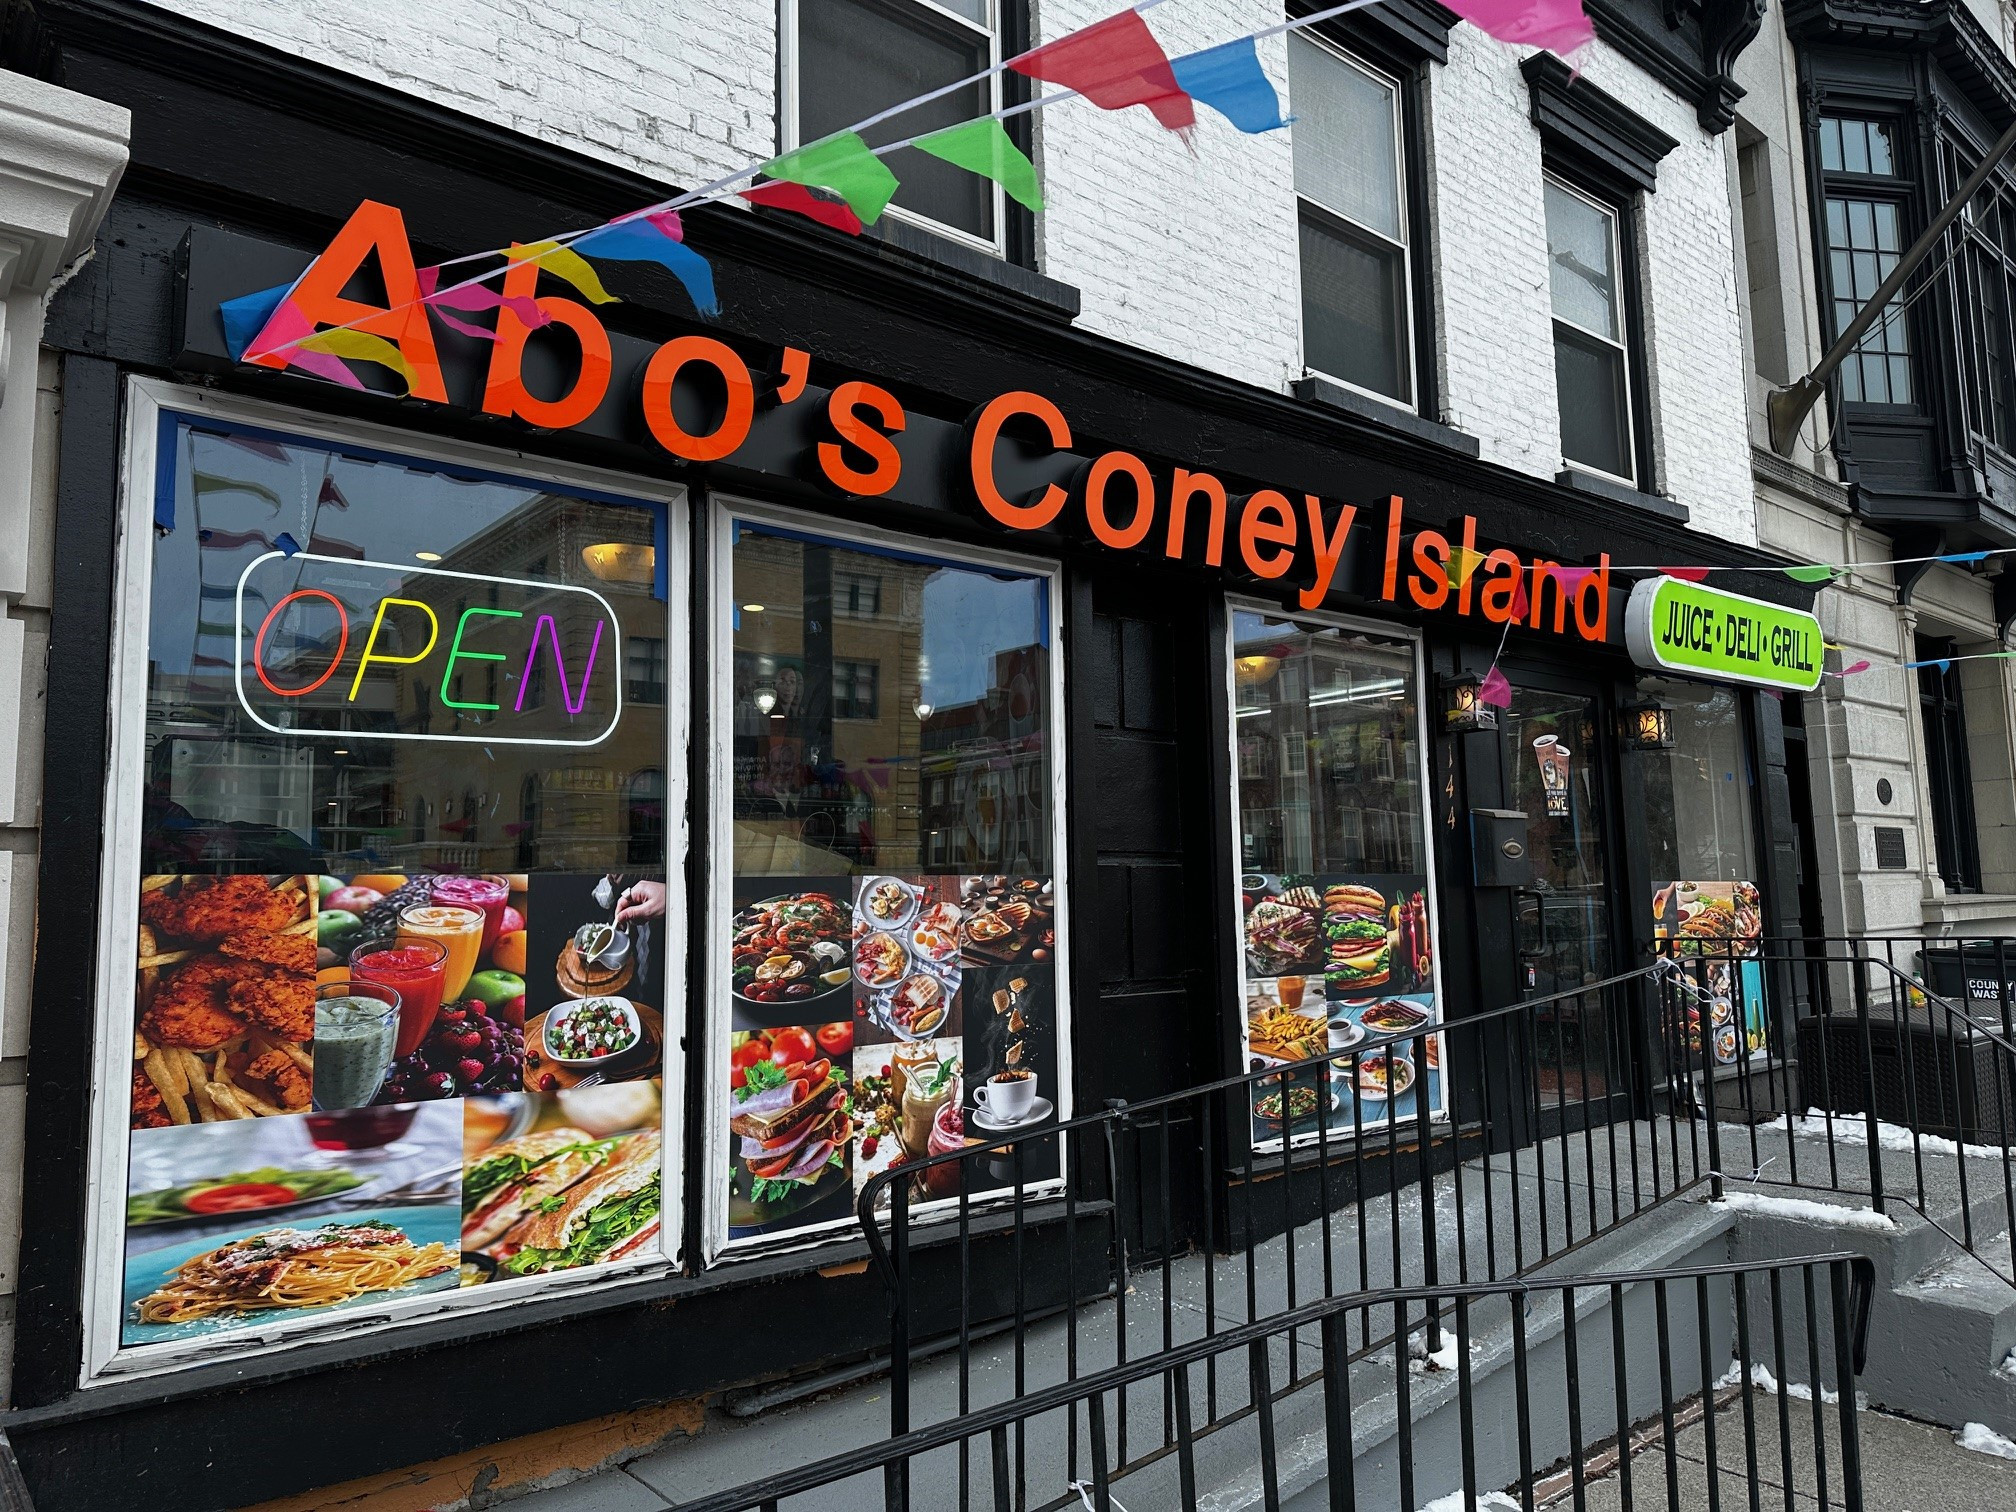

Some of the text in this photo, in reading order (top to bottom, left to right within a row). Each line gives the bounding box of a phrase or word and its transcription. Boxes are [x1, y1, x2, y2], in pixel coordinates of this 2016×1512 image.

[244, 198, 1610, 642] Abo's Coney Island
[254, 588, 604, 714] OPEN
[1662, 600, 1814, 673] JUICE DELI GRILL
[1969, 979, 2014, 991] COUNY
[1972, 989, 2011, 1000] WAS
